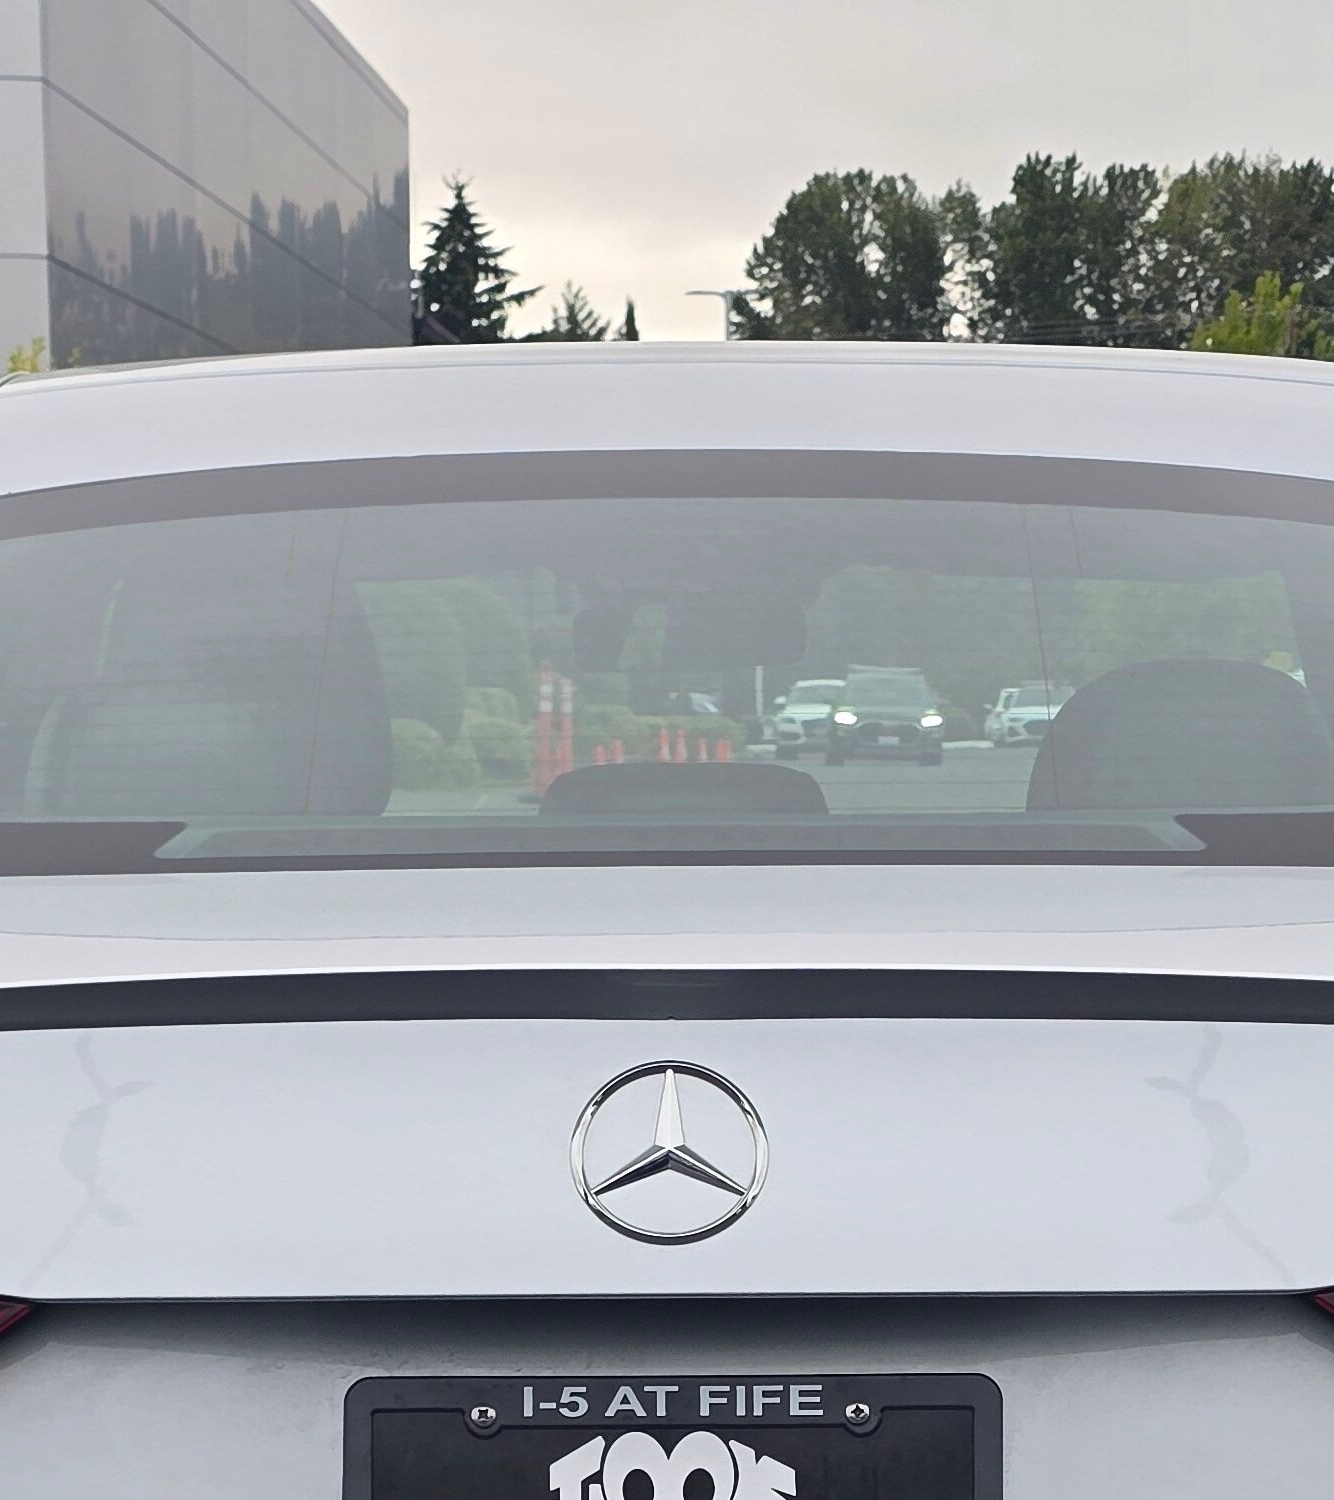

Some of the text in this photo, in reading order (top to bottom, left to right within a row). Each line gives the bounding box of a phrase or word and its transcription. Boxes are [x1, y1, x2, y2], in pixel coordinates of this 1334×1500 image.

[521, 1384, 825, 1418] I-5 AT FIFE
